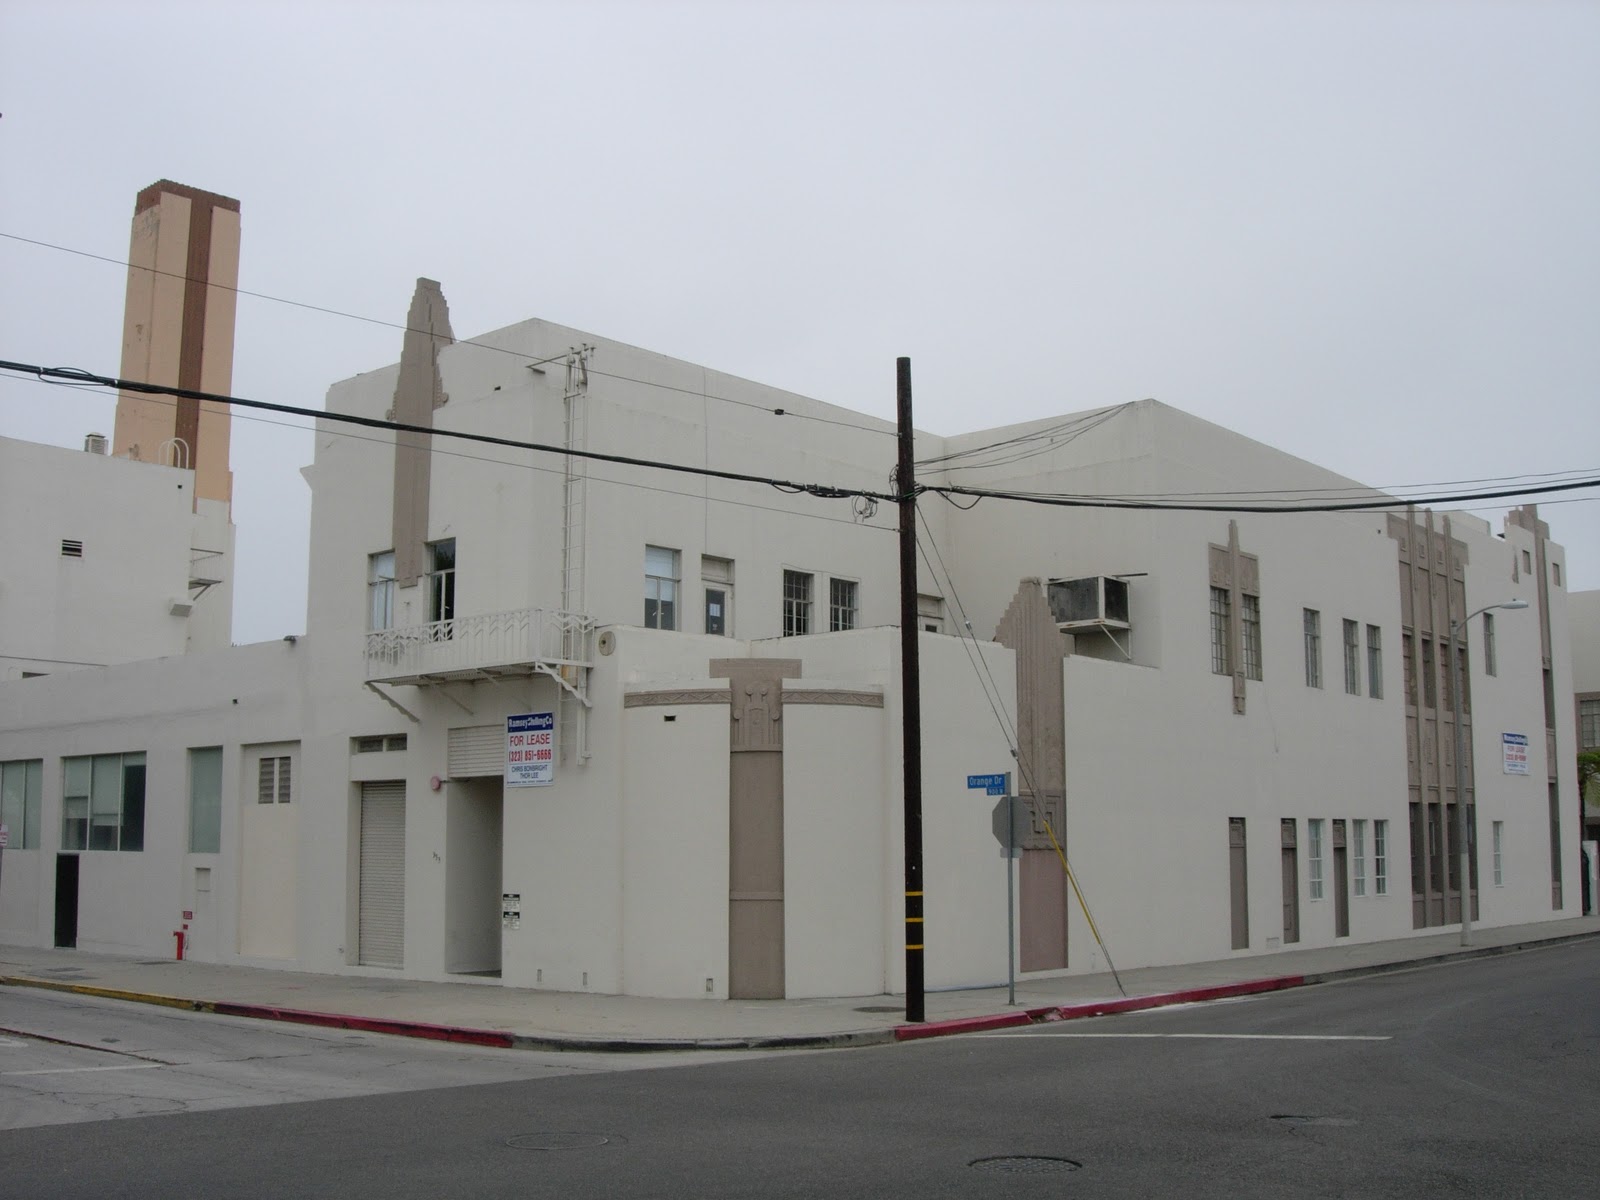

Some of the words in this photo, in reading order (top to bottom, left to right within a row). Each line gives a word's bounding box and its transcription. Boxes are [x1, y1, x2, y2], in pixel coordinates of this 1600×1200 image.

[510, 735, 524, 746] FOR
[527, 733, 550, 745] LEASE
[509, 750, 523, 762] (323)
[969, 777, 992, 787] Orange
[994, 776, 1003, 785] Dr
